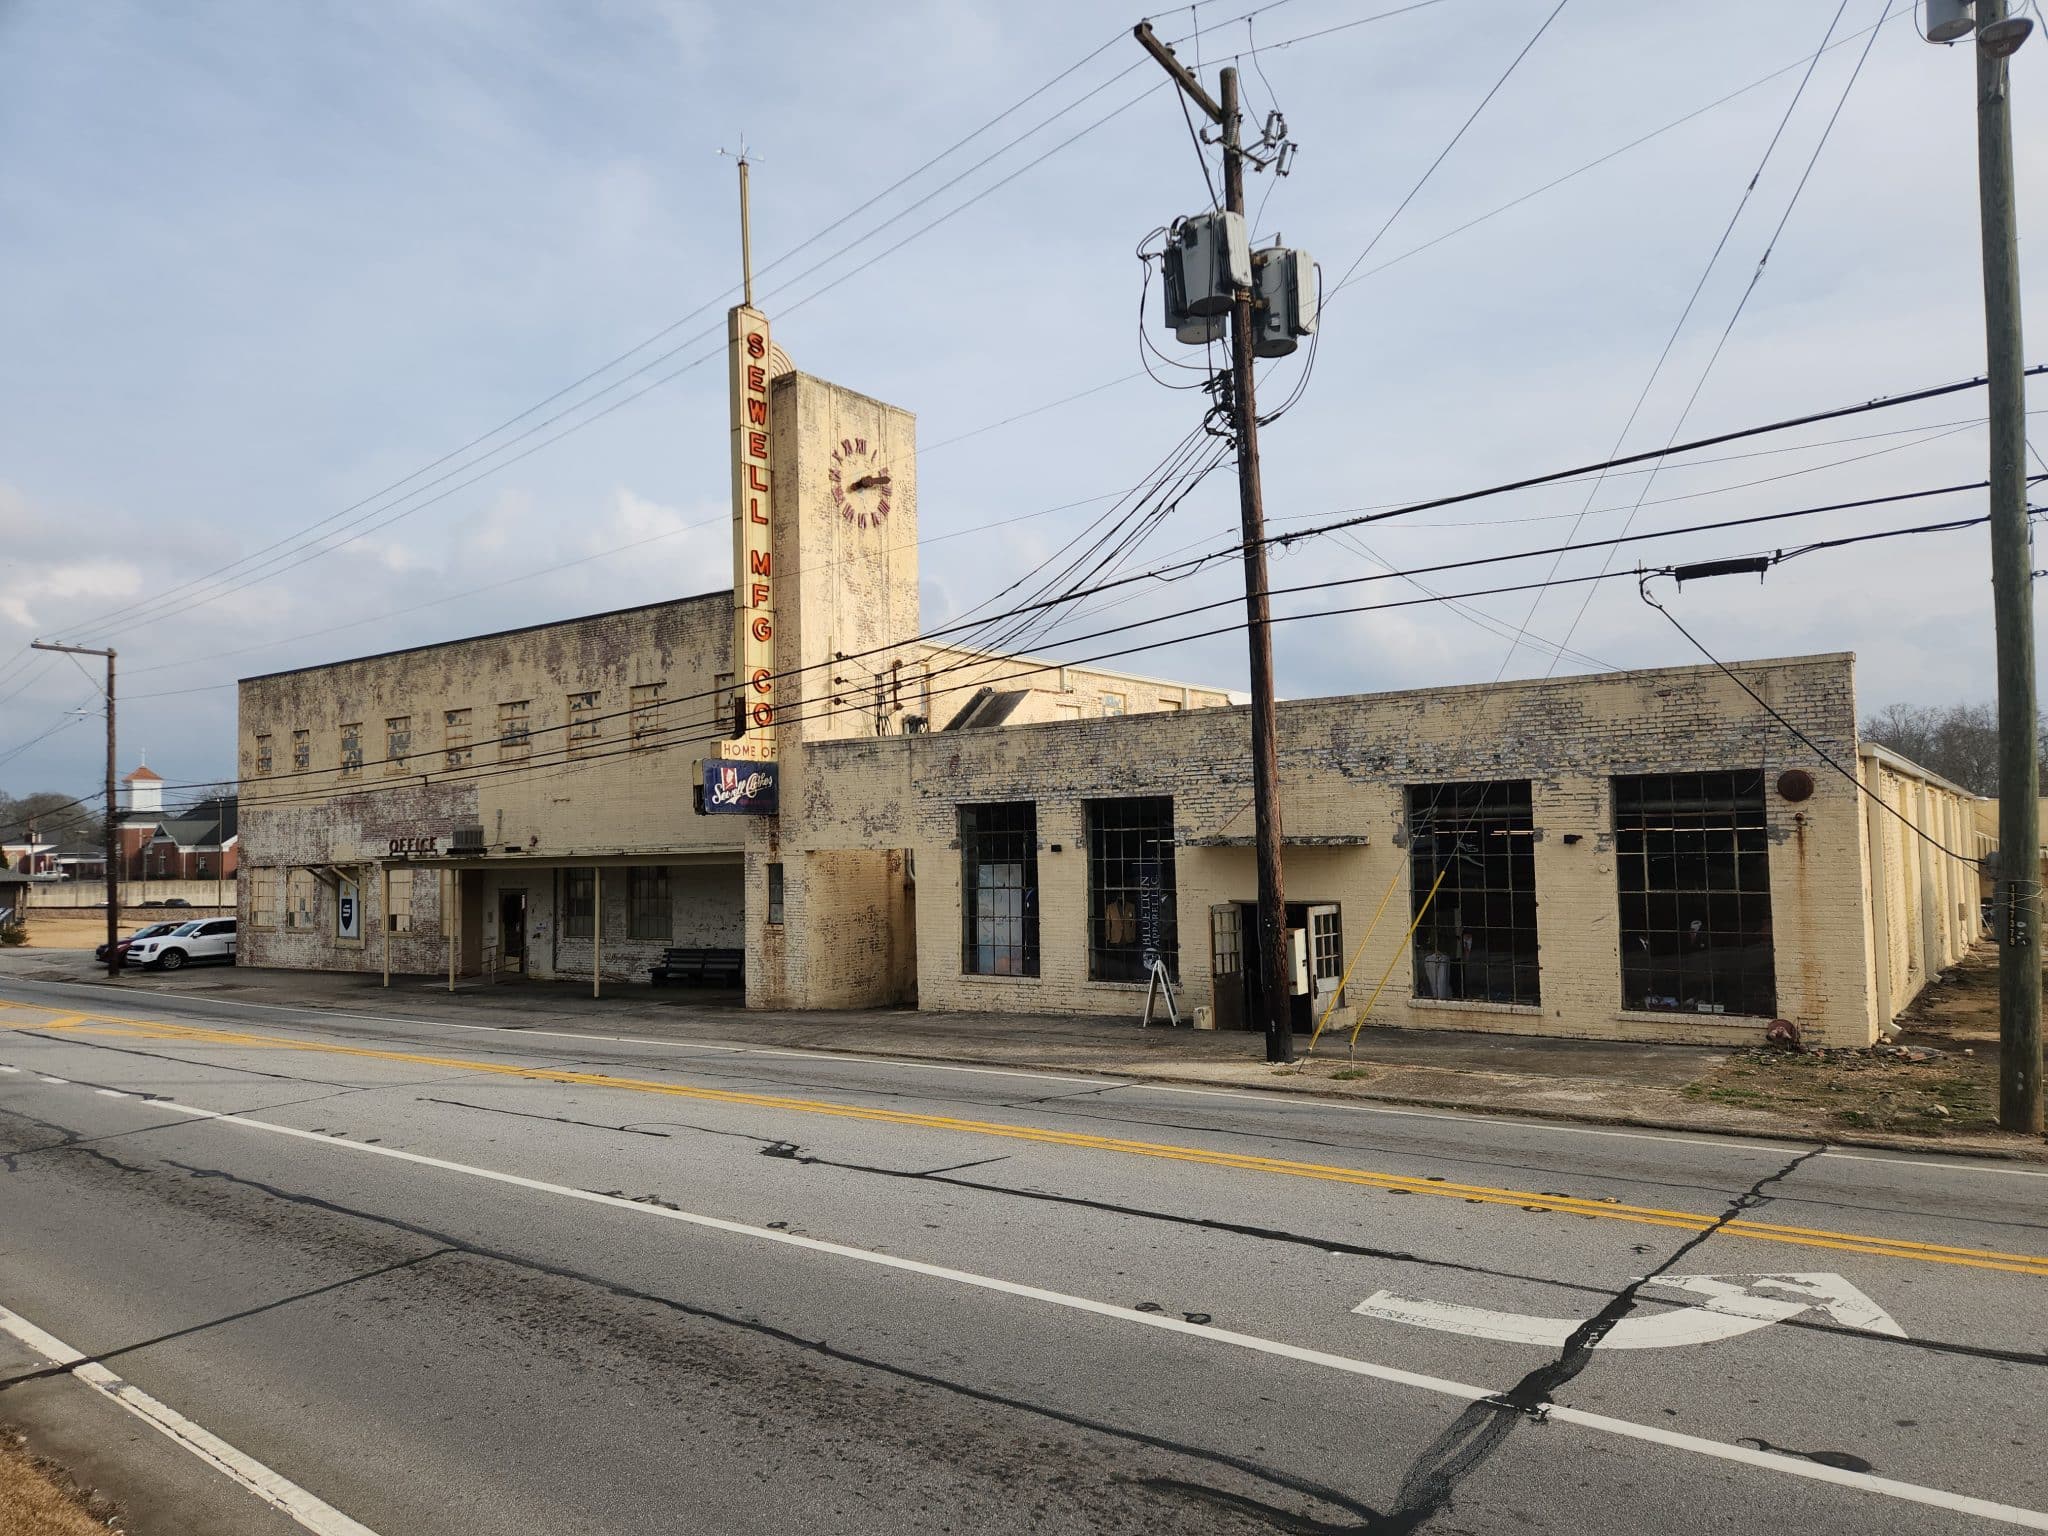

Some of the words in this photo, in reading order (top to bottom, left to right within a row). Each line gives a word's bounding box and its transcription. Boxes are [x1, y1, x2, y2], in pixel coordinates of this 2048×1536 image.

[747, 333, 769, 525] SEWELL
[750, 549, 772, 642] MFG
[752, 668, 773, 727] CO
[724, 743, 756, 757] HOME
[761, 746, 777, 758] OF
[389, 837, 437, 853] OFFICE
[1142, 911, 1151, 946] BLUE
